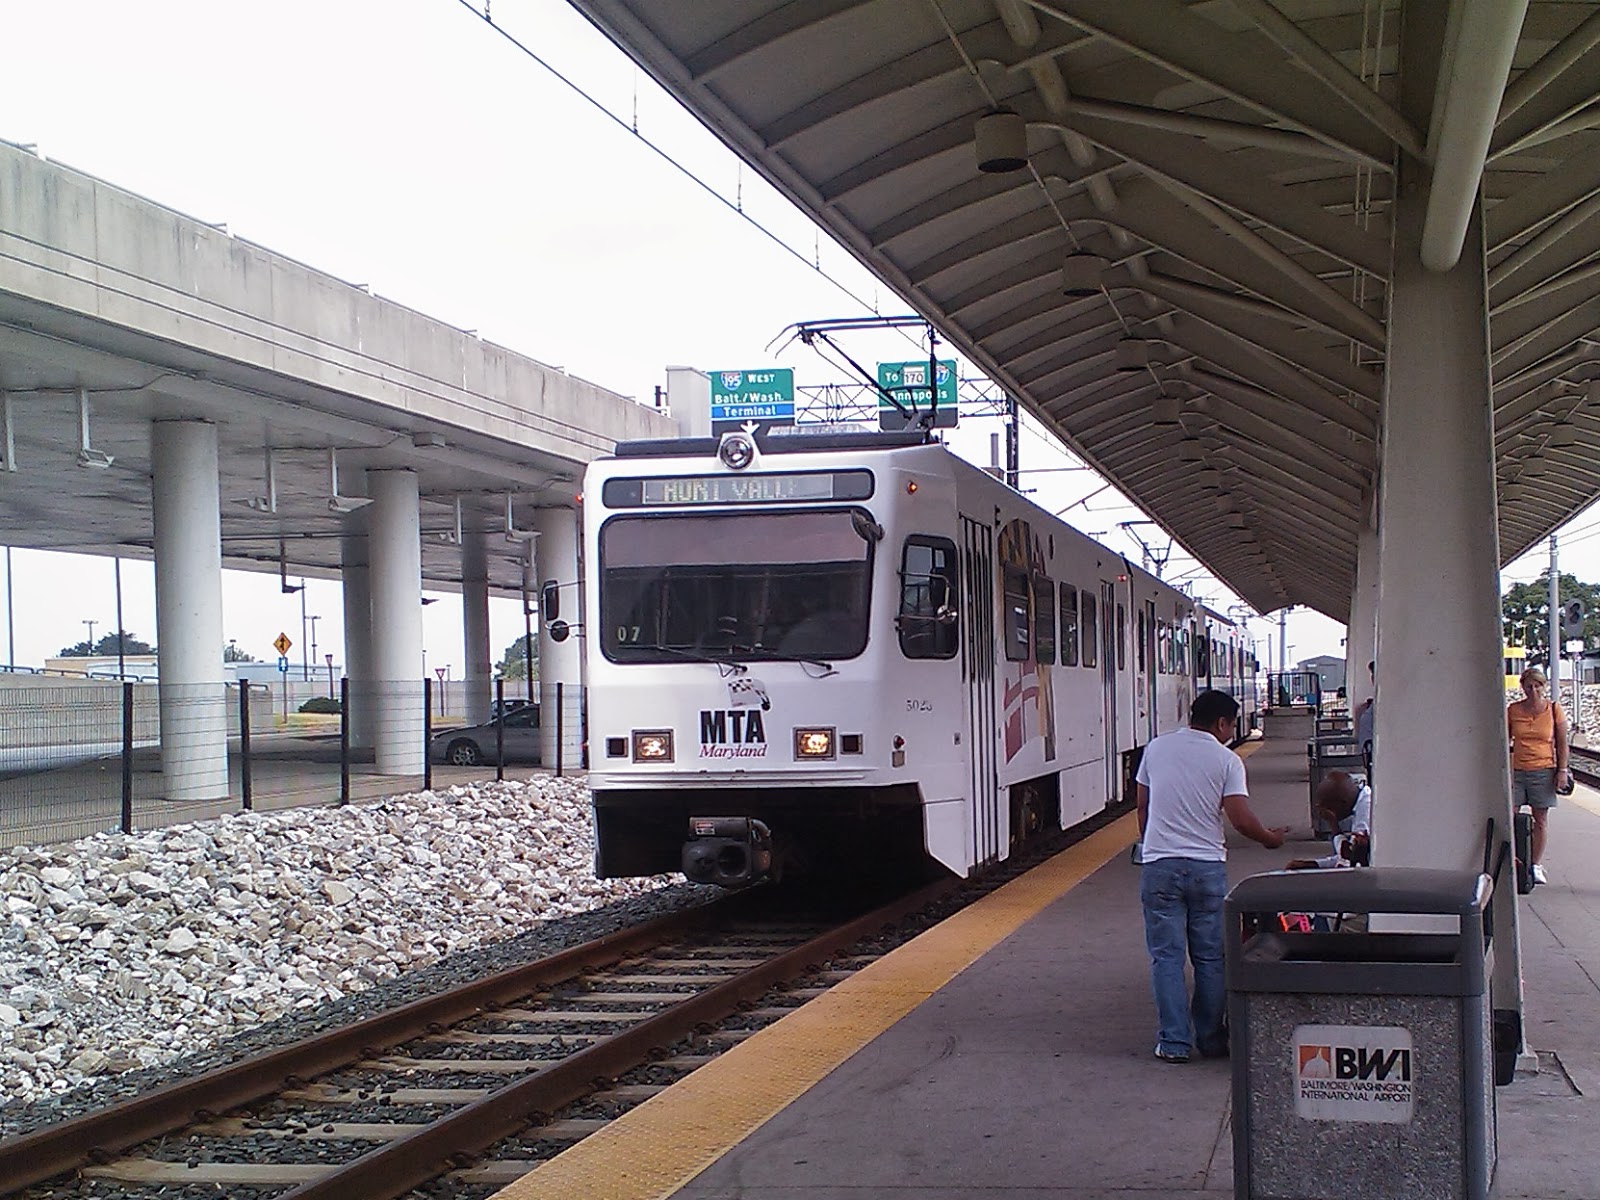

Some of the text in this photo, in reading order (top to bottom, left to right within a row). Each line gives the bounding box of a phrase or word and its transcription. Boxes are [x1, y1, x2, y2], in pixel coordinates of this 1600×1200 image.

[748, 373, 775, 383] WEST
[905, 373, 924, 383] 170
[889, 389, 948, 402] Annapois
[723, 405, 776, 417] Terminal
[701, 710, 765, 743] MTA
[700, 744, 767, 759] Maryland
[1335, 1047, 1411, 1081] BWI
[1301, 1090, 1411, 1103] INTERNATIONAL AIRPORT
